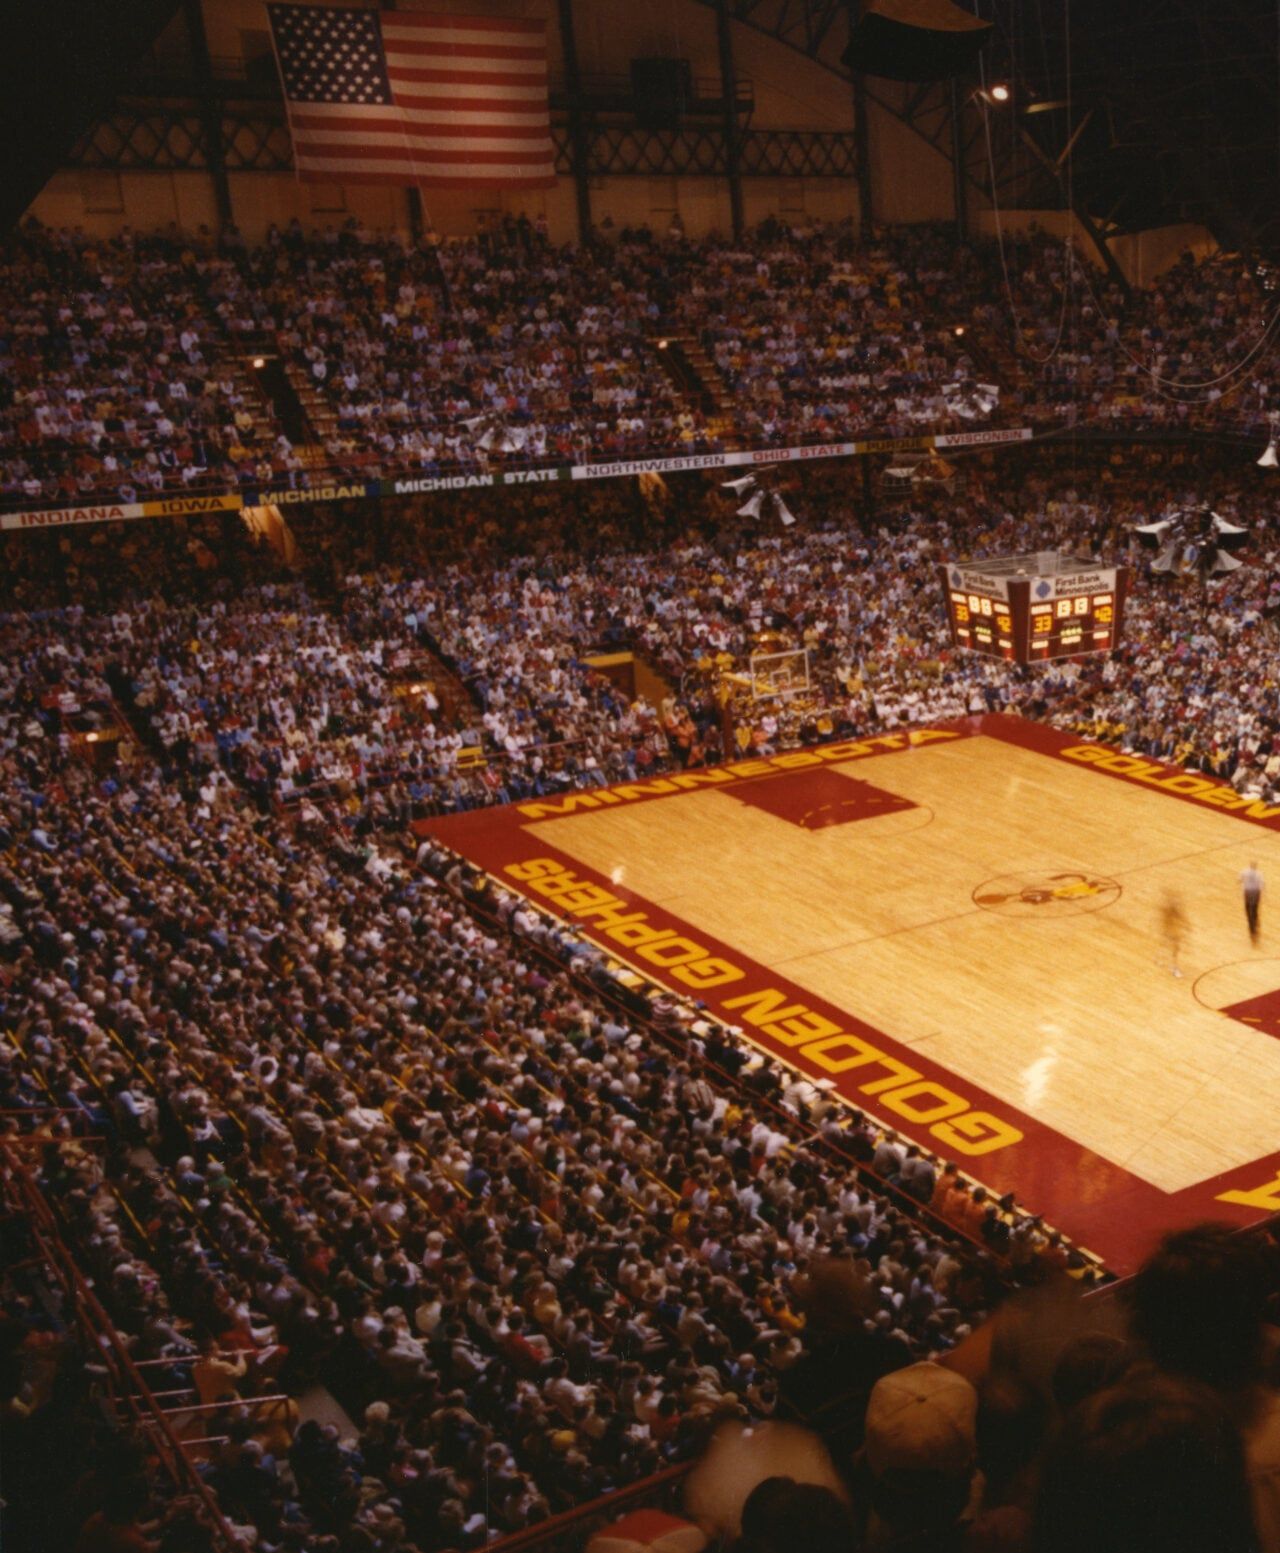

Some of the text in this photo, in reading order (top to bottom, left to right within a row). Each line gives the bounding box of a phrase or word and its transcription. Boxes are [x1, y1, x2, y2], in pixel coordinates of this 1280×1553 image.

[866, 437, 924, 452] PURDUE
[945, 430, 1023, 446] WISCONSIN
[752, 443, 845, 463] OHIO STATE
[586, 454, 726, 477] NORTHWESTERN
[395, 468, 560, 493] MICHIGAN STATE
[257, 485, 367, 505] MICHIGAN
[161, 497, 225, 514] IOWA
[20, 507, 124, 526] INDIANA
[1055, 574, 1101, 587] First Bank
[1055, 581, 1110, 597] Minneapolis
[516, 728, 961, 819] MINNESOTA
[503, 857, 1024, 1156] GOLDEN GOPHERS
